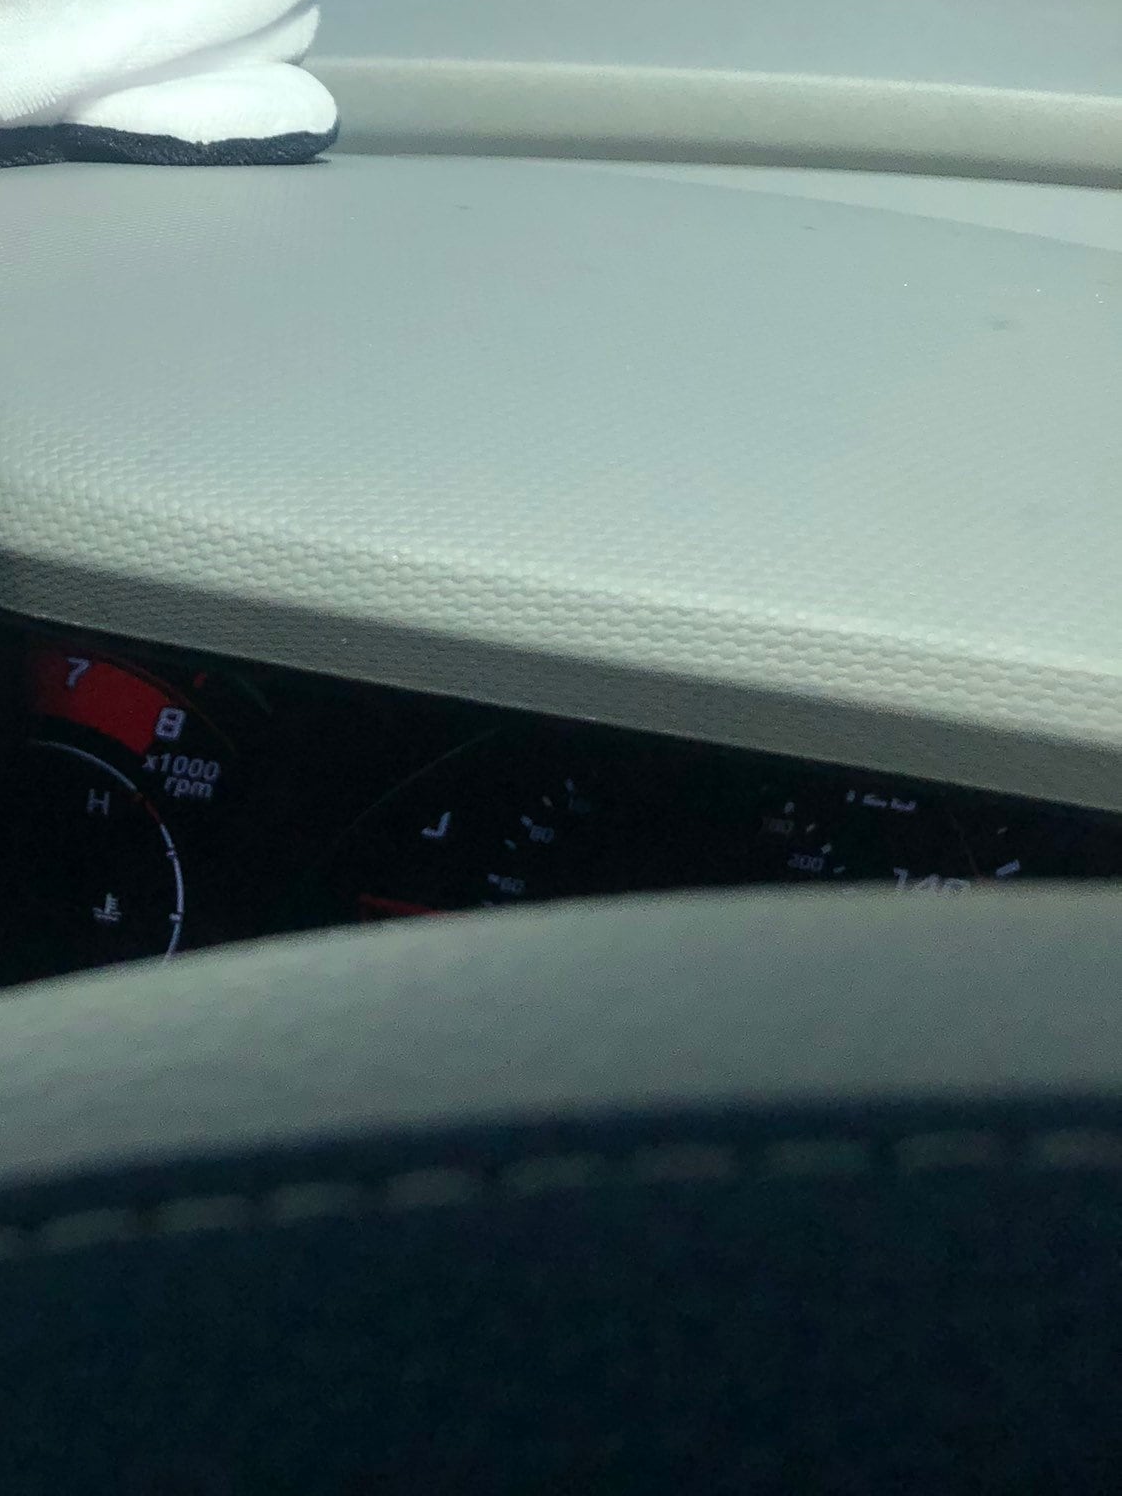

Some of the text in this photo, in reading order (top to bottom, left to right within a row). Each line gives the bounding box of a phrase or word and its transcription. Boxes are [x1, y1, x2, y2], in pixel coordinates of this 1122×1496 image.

[63, 656, 90, 689] 7
[154, 708, 186, 741] 8
[163, 776, 214, 801] rpm
[87, 791, 111, 816] H
